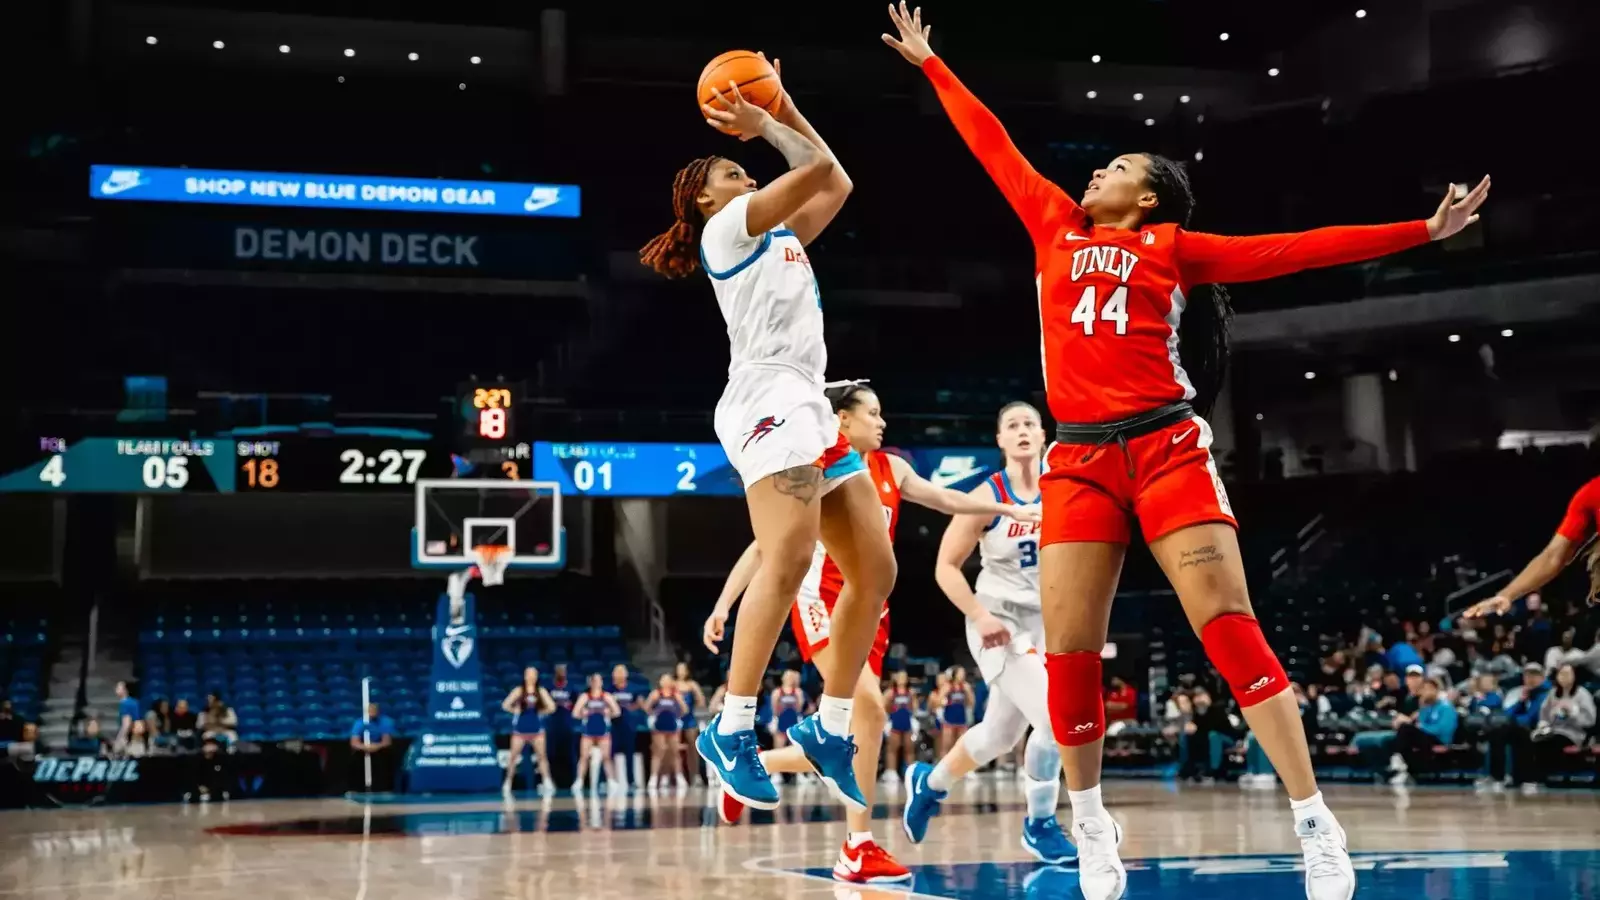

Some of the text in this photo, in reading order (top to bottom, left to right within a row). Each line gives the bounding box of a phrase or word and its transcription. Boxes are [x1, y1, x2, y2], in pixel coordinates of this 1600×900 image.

[185, 177, 496, 205] SHOP NEW BLUE DEMON GEAR
[235, 228, 479, 266] DEMON DECK
[1070, 245, 1139, 284] UNLV
[1070, 284, 1129, 336] 44
[480, 408, 506, 438] 18
[237, 441, 281, 456] SHOT
[39, 455, 67, 487] 4
[142, 456, 189, 488] 05
[241, 458, 280, 488] 18
[339, 450, 427, 484] 2:27
[574, 460, 612, 491] 01
[676, 461, 697, 491] 2
